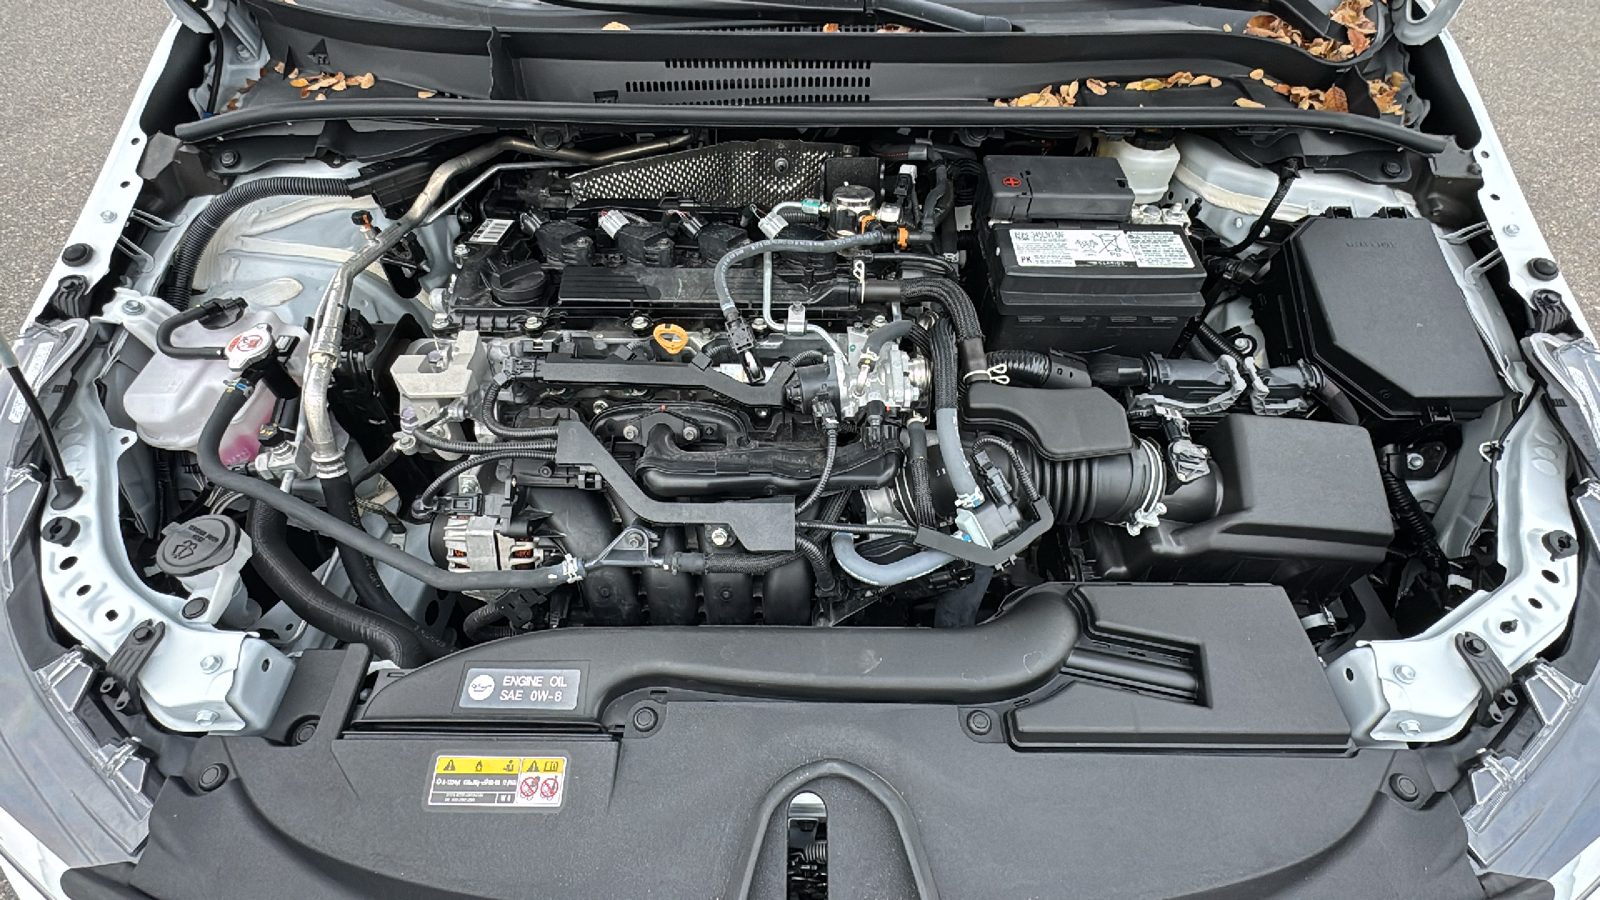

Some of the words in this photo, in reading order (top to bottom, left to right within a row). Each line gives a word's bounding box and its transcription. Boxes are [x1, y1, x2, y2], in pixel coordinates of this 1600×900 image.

[502, 675, 544, 688] ENGINE
[549, 675, 568, 688] OIL
[499, 689, 524, 701] SAE
[530, 690, 563, 703] 0W-8
